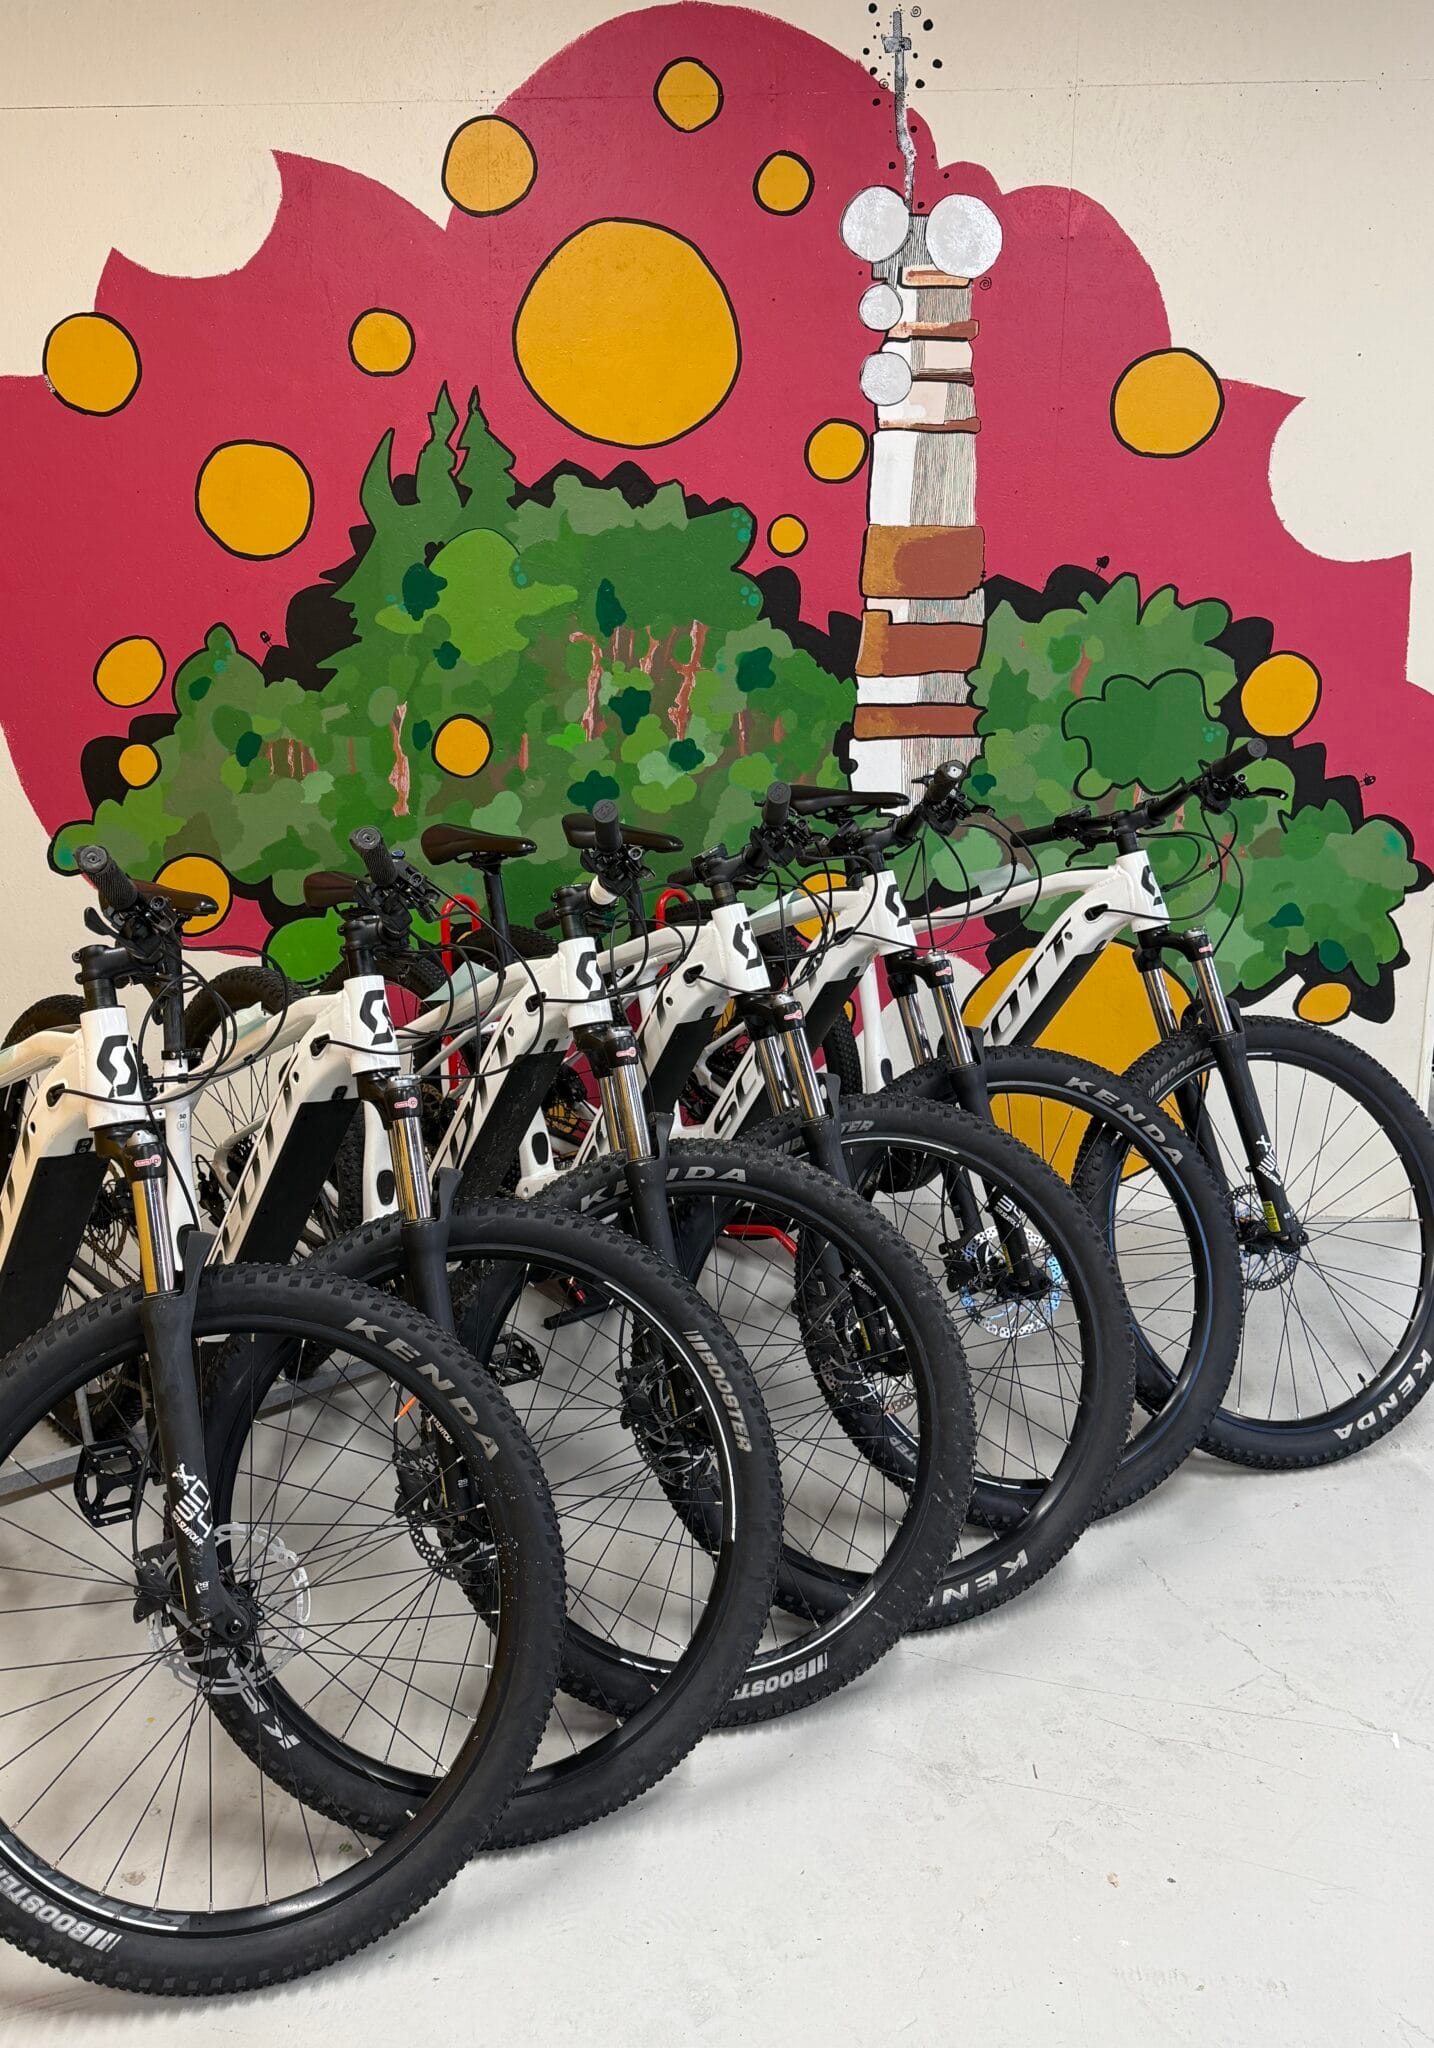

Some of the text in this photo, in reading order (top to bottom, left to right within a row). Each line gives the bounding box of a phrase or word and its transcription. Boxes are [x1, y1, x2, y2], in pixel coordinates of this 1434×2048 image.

[1064, 1076, 1184, 1166] KENDA
[344, 1317, 500, 1461] KENDA
[696, 1351, 753, 1452] BOOSTER
[1333, 1349, 1433, 1440] KENDA
[926, 1548, 1028, 1608] KEN
